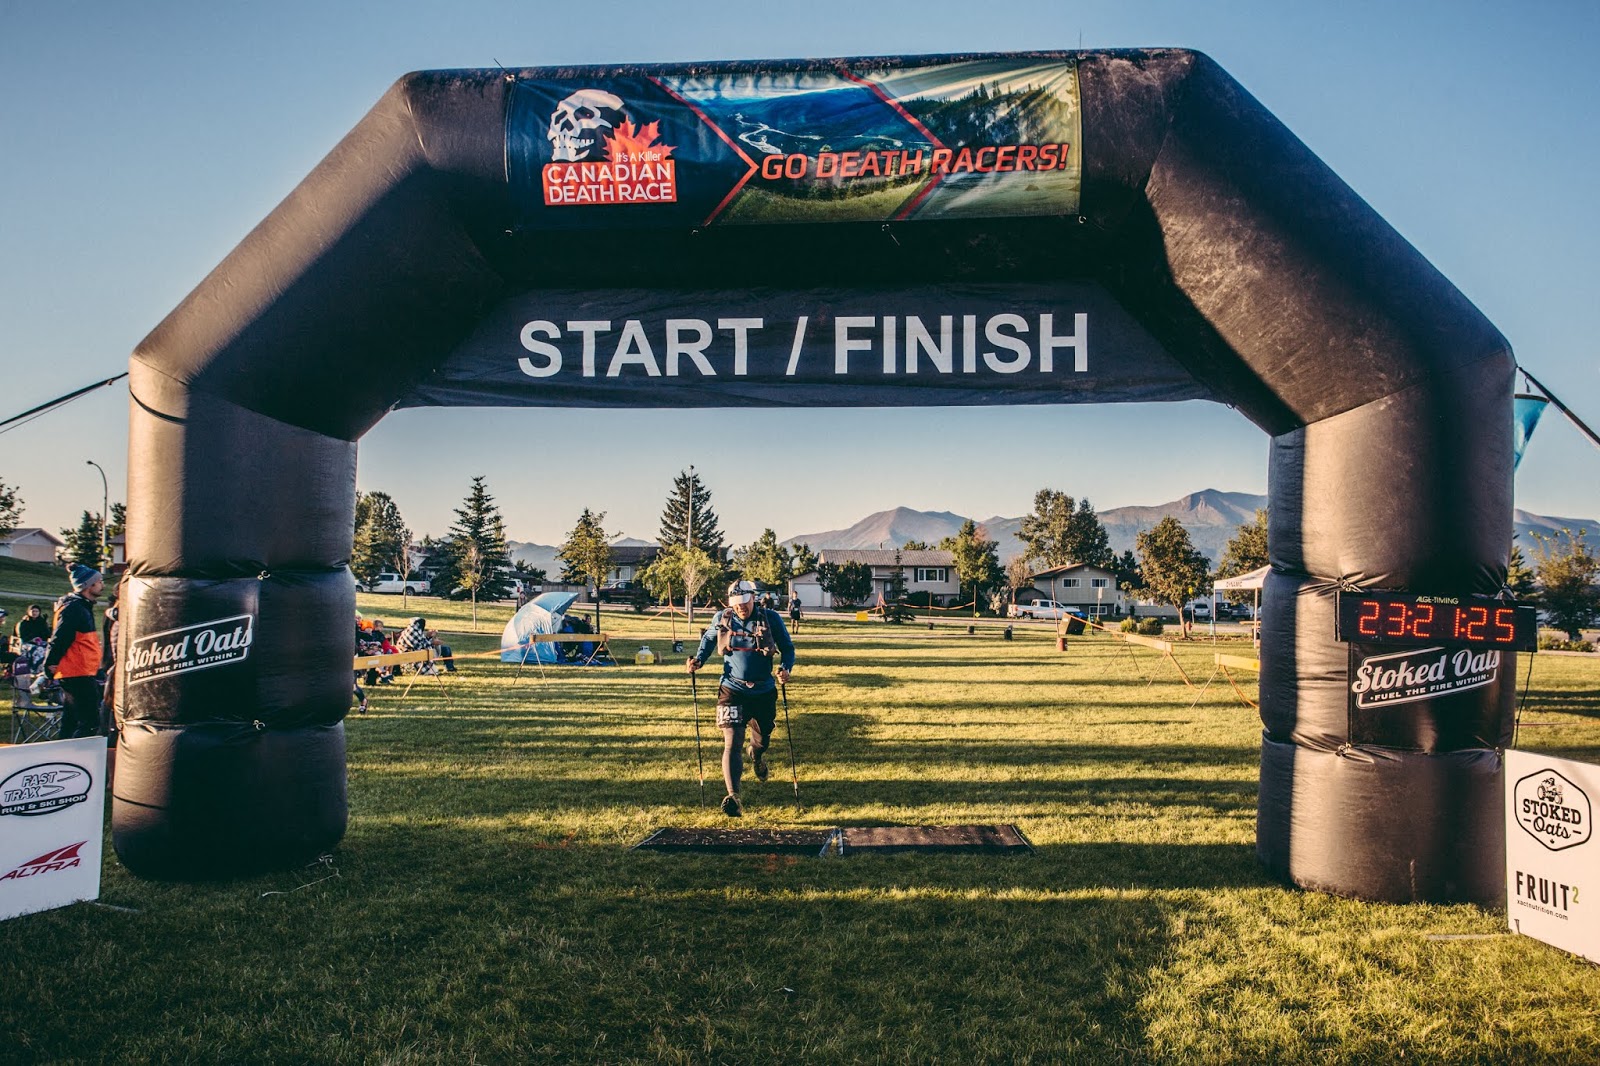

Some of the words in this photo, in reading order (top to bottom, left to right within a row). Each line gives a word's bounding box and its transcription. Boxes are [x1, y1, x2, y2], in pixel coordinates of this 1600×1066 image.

[616, 152, 628, 162] It's
[629, 152, 637, 162] A
[638, 151, 661, 161] Killer
[761, 153, 807, 180] GO
[815, 149, 921, 178] DEATH
[930, 143, 1069, 174] RACERS!
[547, 163, 671, 184] CANADIAN
[549, 184, 615, 203] DEATH
[619, 182, 672, 200] RACE
[517, 317, 764, 378] START
[834, 312, 1088, 375] FINISH
[126, 635, 187, 671] Stoked
[194, 626, 252, 655] Oats
[135, 670, 153, 679] FUEL
[154, 665, 171, 674] THE
[173, 660, 194, 670] FIRE
[197, 652, 233, 664] WITHIN
[1352, 654, 1446, 693] Stoked
[1452, 649, 1500, 677] Oats
[1374, 692, 1401, 701] FUEL
[1405, 688, 1426, 696] THE
[1430, 681, 1453, 691] FIRE
[1456, 674, 1487, 686] WITHIN
[22, 771, 57, 787] FAST
[1, 805, 25, 814] RUN
[39, 799, 56, 808] SKI
[58, 795, 86, 804] SHOP
[4, 786, 41, 803] TRAX
[1523, 798, 1581, 825] STOKED
[1533, 816, 1571, 839] Oats
[0, 858, 81, 881] ALTRA
[1516, 899, 1569, 921] xactnutrition.com
